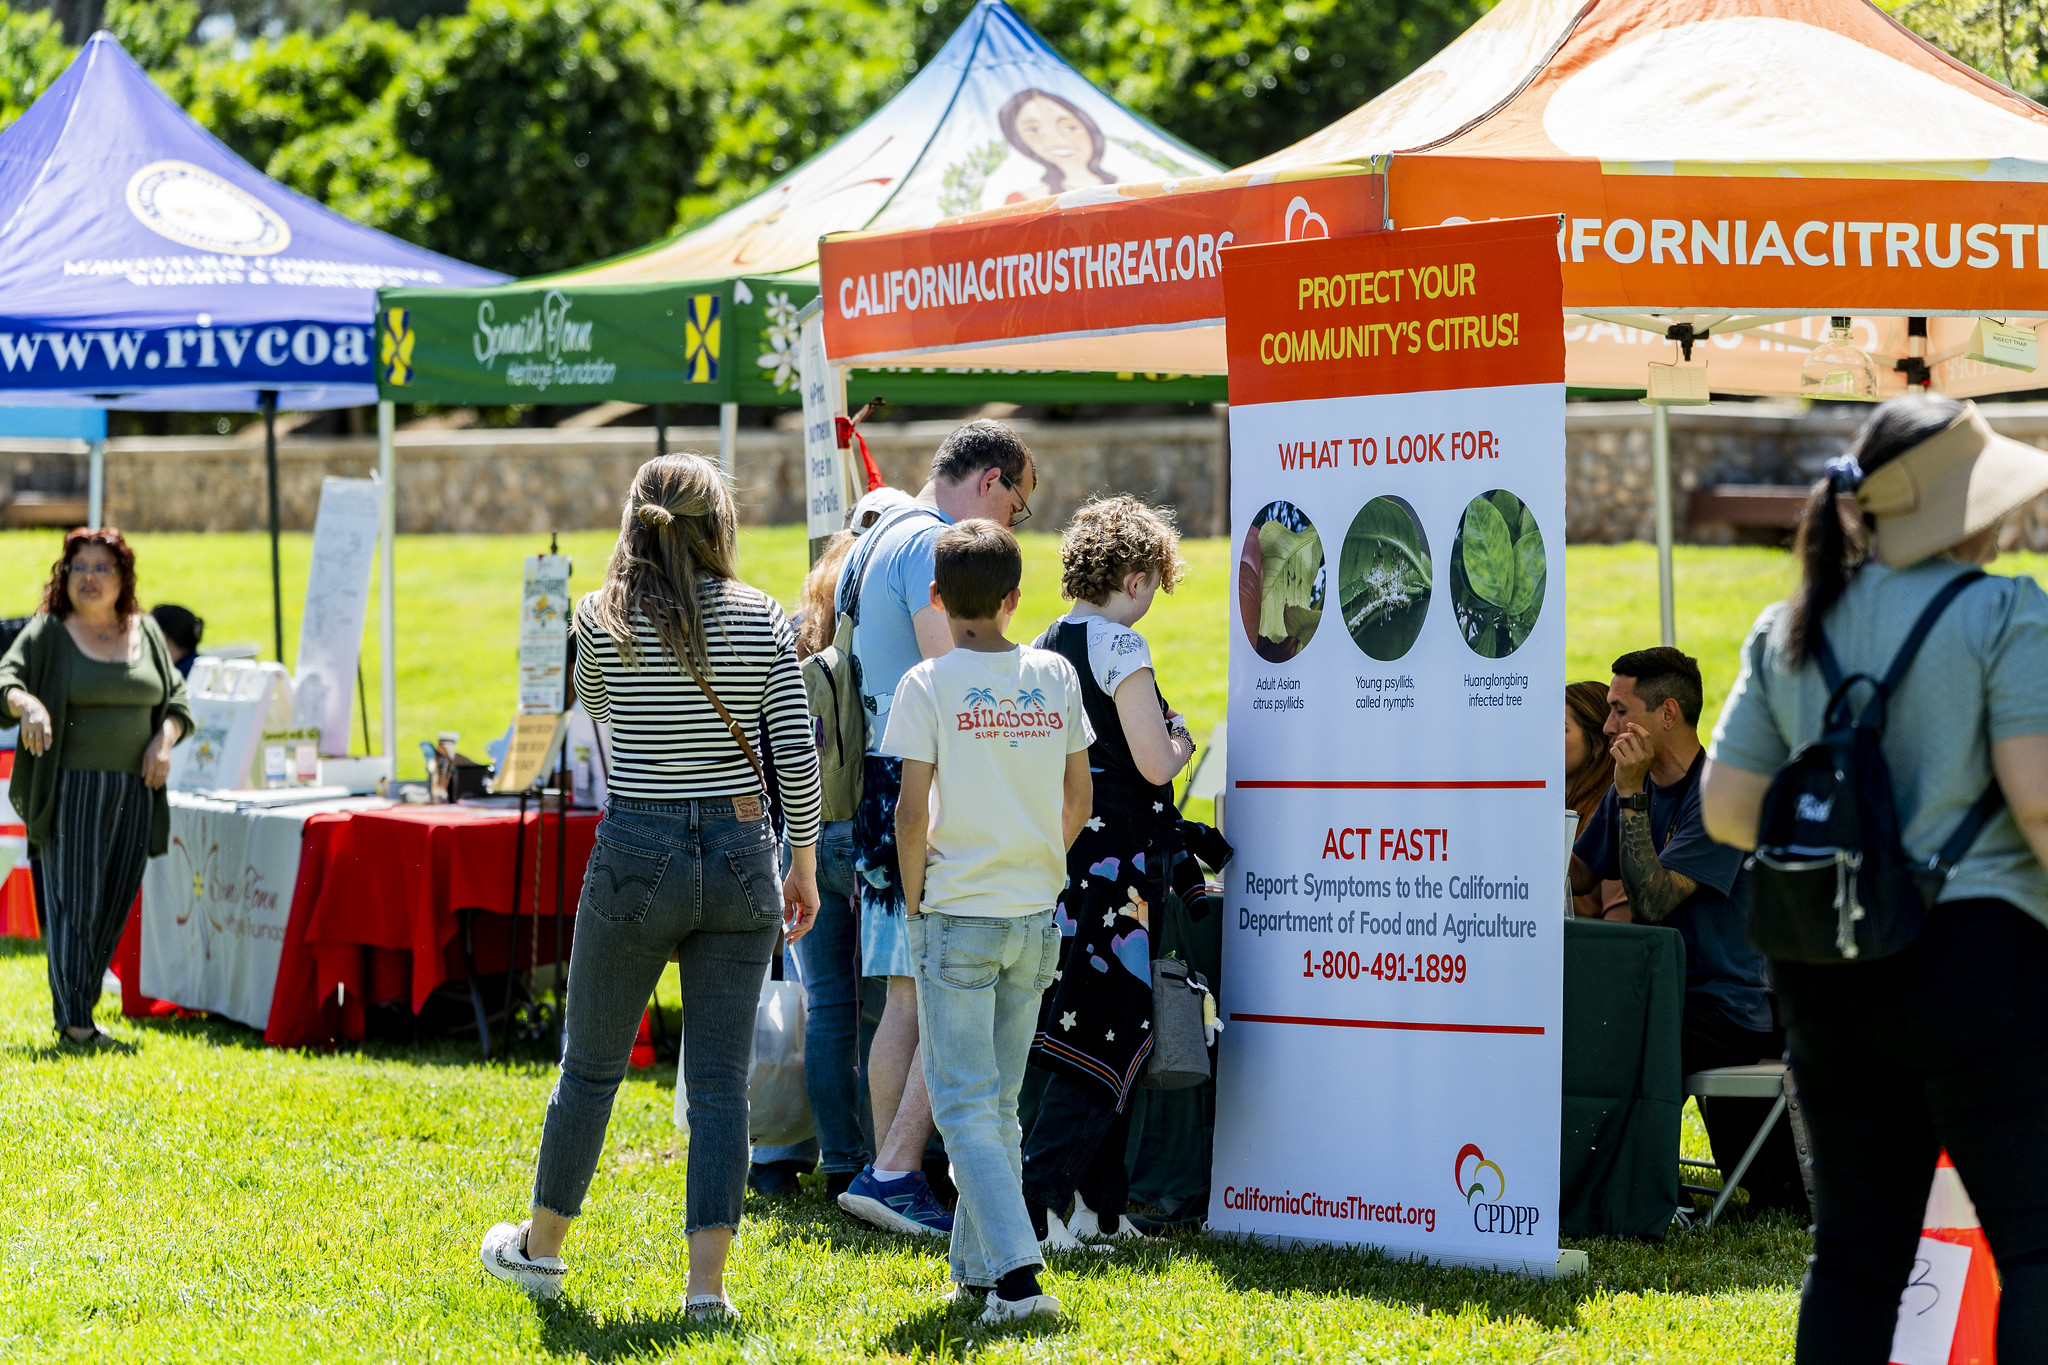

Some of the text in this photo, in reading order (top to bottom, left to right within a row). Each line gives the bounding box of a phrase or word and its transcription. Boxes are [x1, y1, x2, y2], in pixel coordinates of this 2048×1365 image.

[1440, 216, 2048, 269] IFORNIACITRUST
[1298, 263, 1476, 311] PROTECT YOUR
[0, 318, 375, 373] www.rivcoa
[1260, 312, 1519, 365] COMMUNITY'S CITRUS!
[1278, 430, 1499, 470] WHAT TO LOOK FOR:
[1256, 677, 1300, 691] Adult Asian
[1355, 675, 1415, 692] Young psyllids,
[1463, 673, 1529, 692] Huanglongbing
[1253, 696, 1304, 713] citrus psyllids
[1355, 695, 1414, 711] called nymphs
[1468, 693, 1523, 707] infected tree
[956, 709, 1063, 731] Billabong
[975, 730, 1051, 739] SURF COMPANY
[1322, 828, 1448, 862] ACT FAST!
[1246, 871, 1529, 903] Report Symptoms to the California
[1239, 907, 1537, 943] Department of Food and Agriculture
[1303, 949, 1467, 984] 1-800-491-1899
[1223, 1186, 1436, 1232] CaliforniaCitrusThreat.org
[1474, 1203, 1539, 1236] CPDPP
